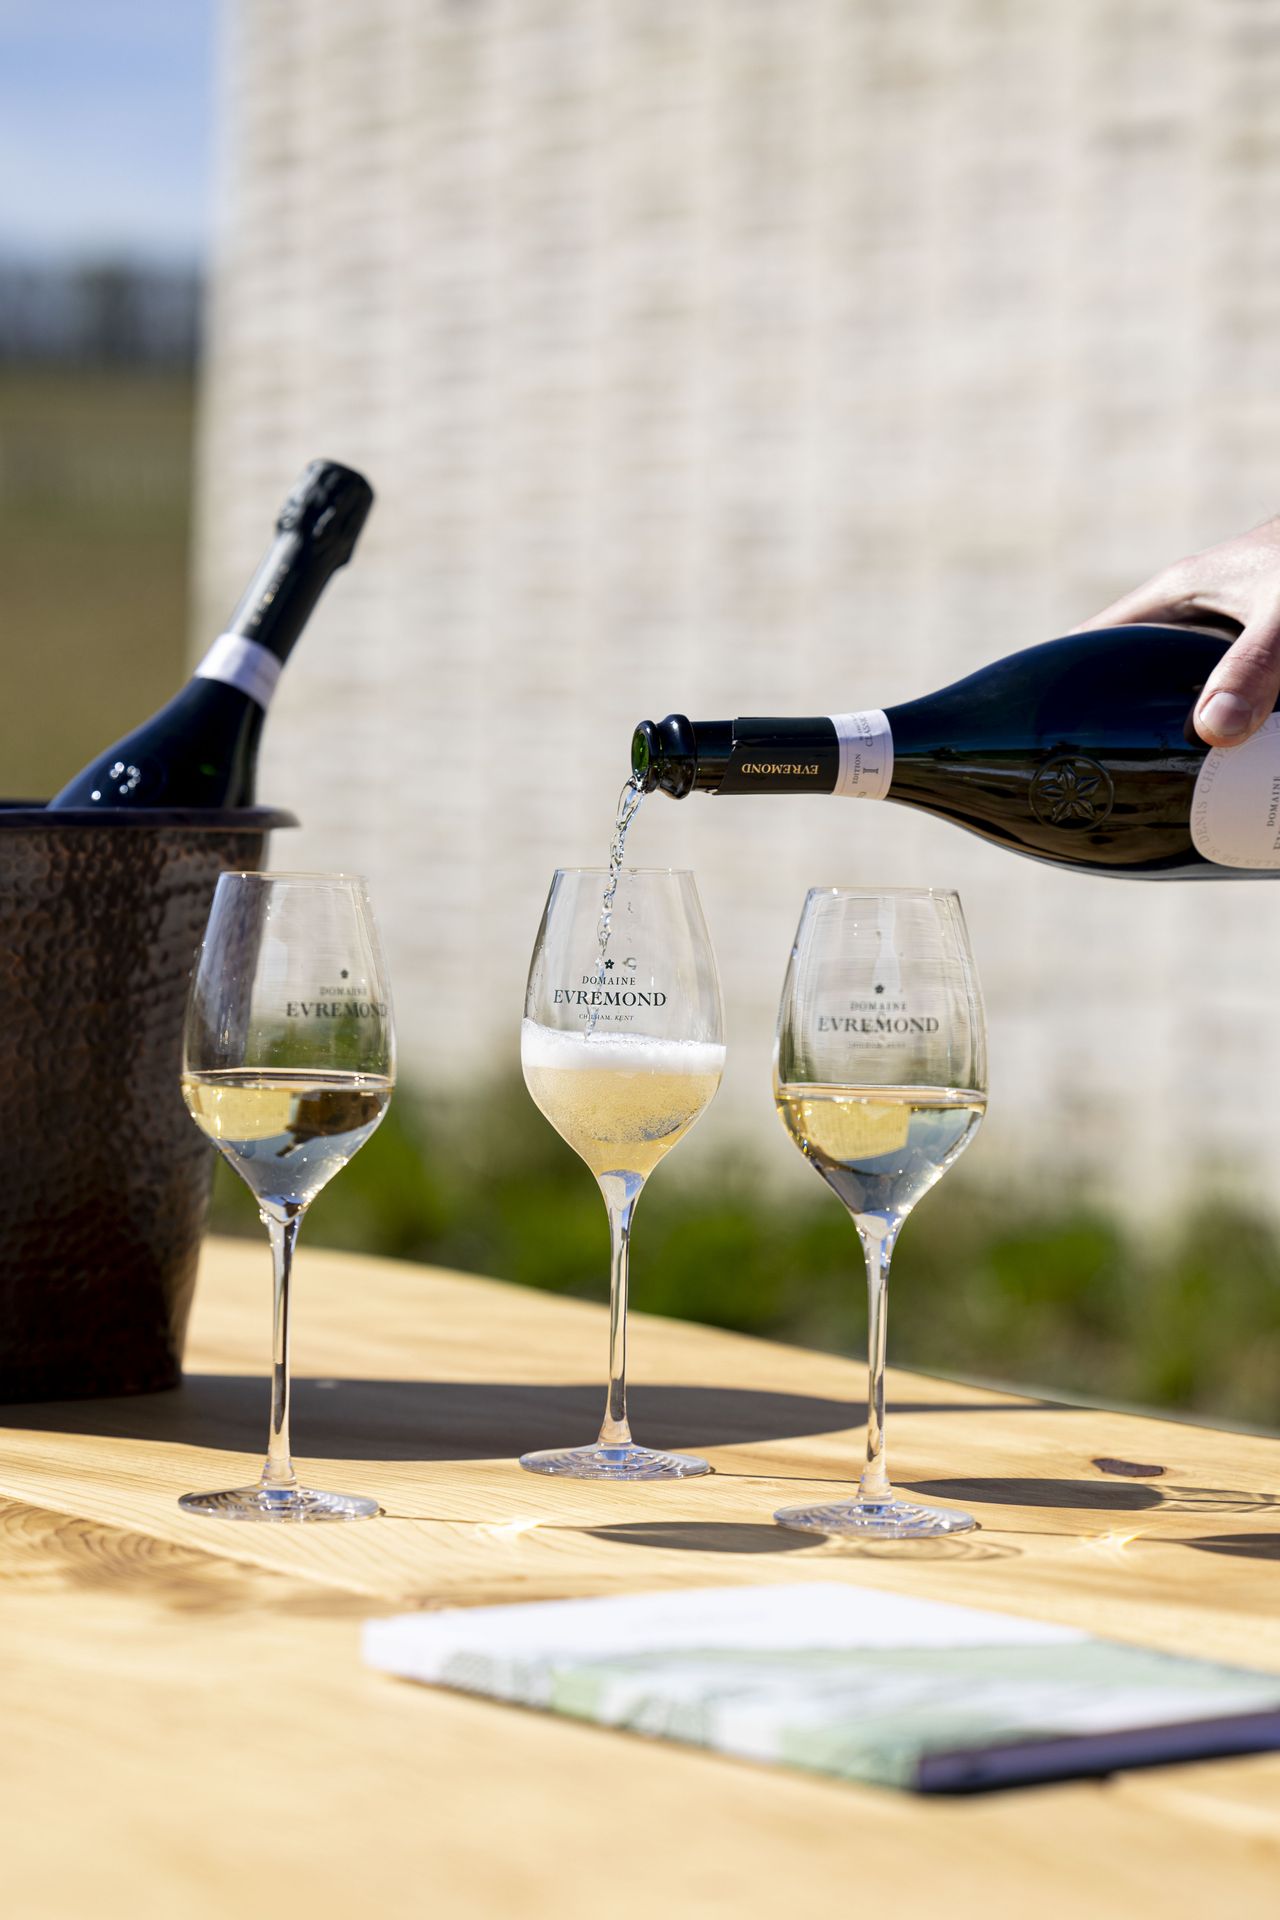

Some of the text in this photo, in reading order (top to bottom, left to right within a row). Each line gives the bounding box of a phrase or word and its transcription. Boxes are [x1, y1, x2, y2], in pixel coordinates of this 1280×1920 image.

[741, 763, 819, 775] EVREMOND
[852, 753, 861, 784] EDITION
[582, 976, 636, 985] DOMAINE
[554, 990, 667, 1006] EVREMOND
[850, 1001, 906, 1010] DOMAINE
[818, 1016, 939, 1033] EVREMOND
